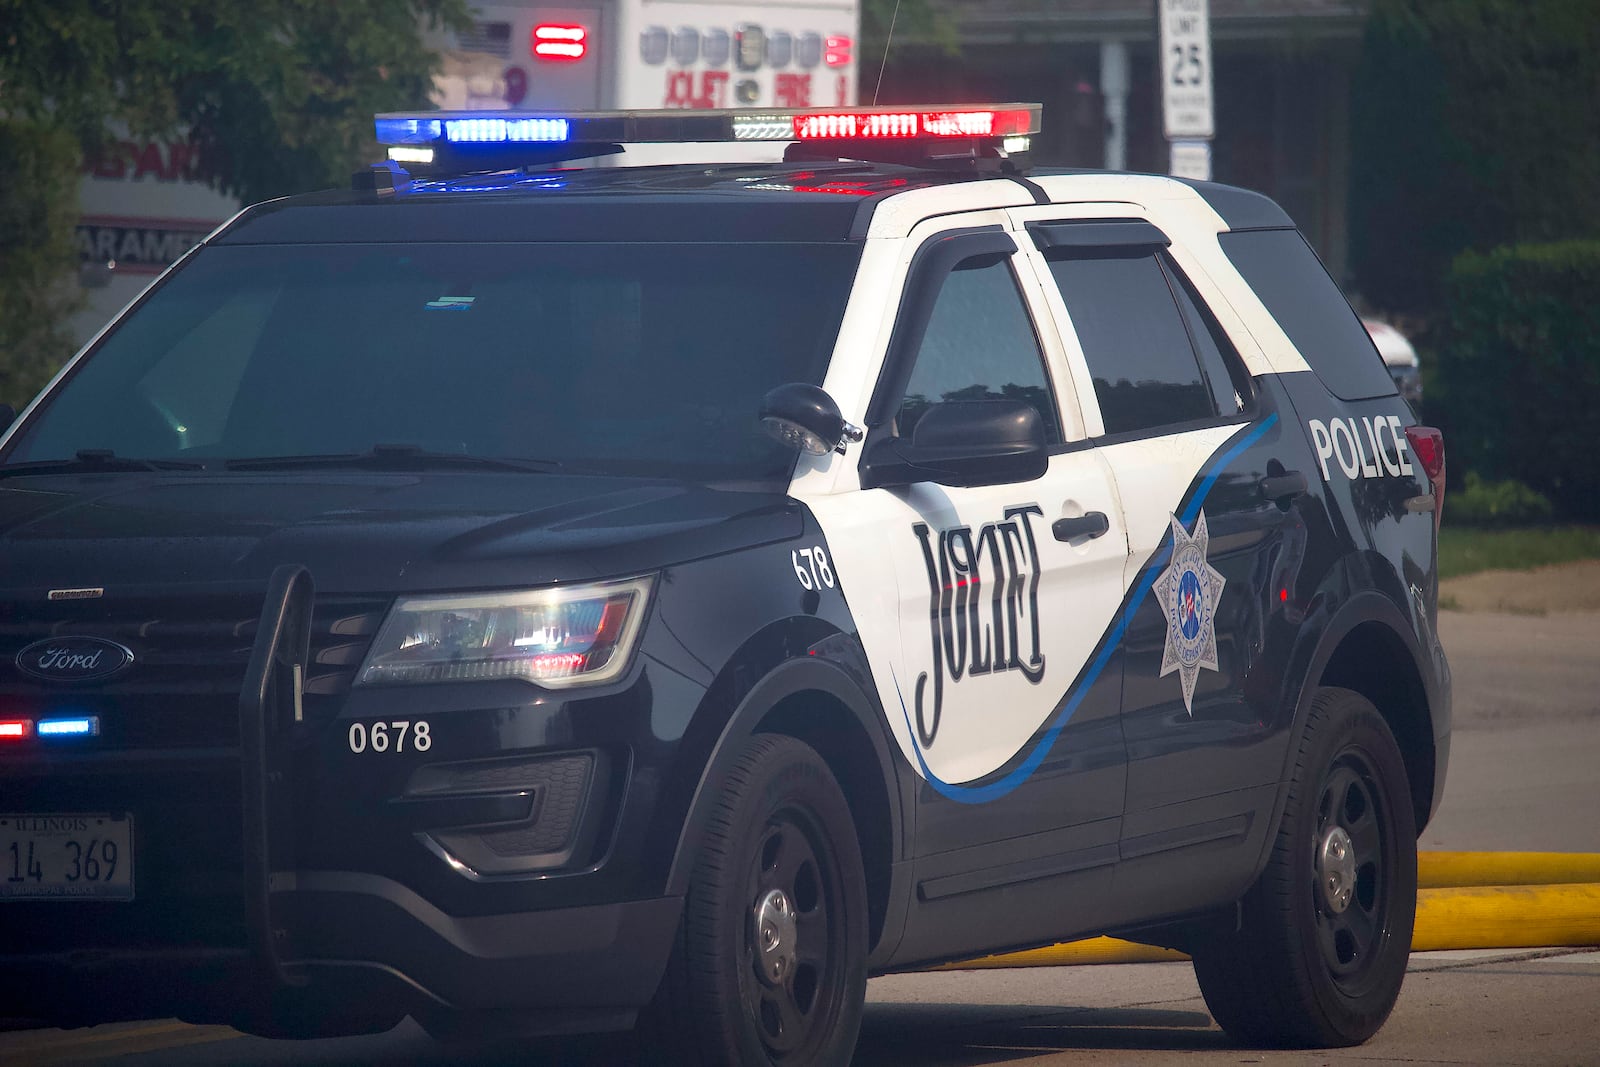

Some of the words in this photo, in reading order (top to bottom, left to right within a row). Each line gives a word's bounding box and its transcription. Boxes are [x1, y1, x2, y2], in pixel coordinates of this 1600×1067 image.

[1172, 44, 1203, 87] 25
[74, 228, 198, 260] ARAME
[1309, 415, 1414, 481] POLICE
[792, 546, 834, 591] 678
[911, 501, 1045, 750] JOLIET
[39, 647, 103, 669] Ford
[348, 720, 432, 754] 0678
[16, 819, 88, 832] ILLINOIS
[7, 841, 43, 882] 14
[65, 839, 118, 881] 369
